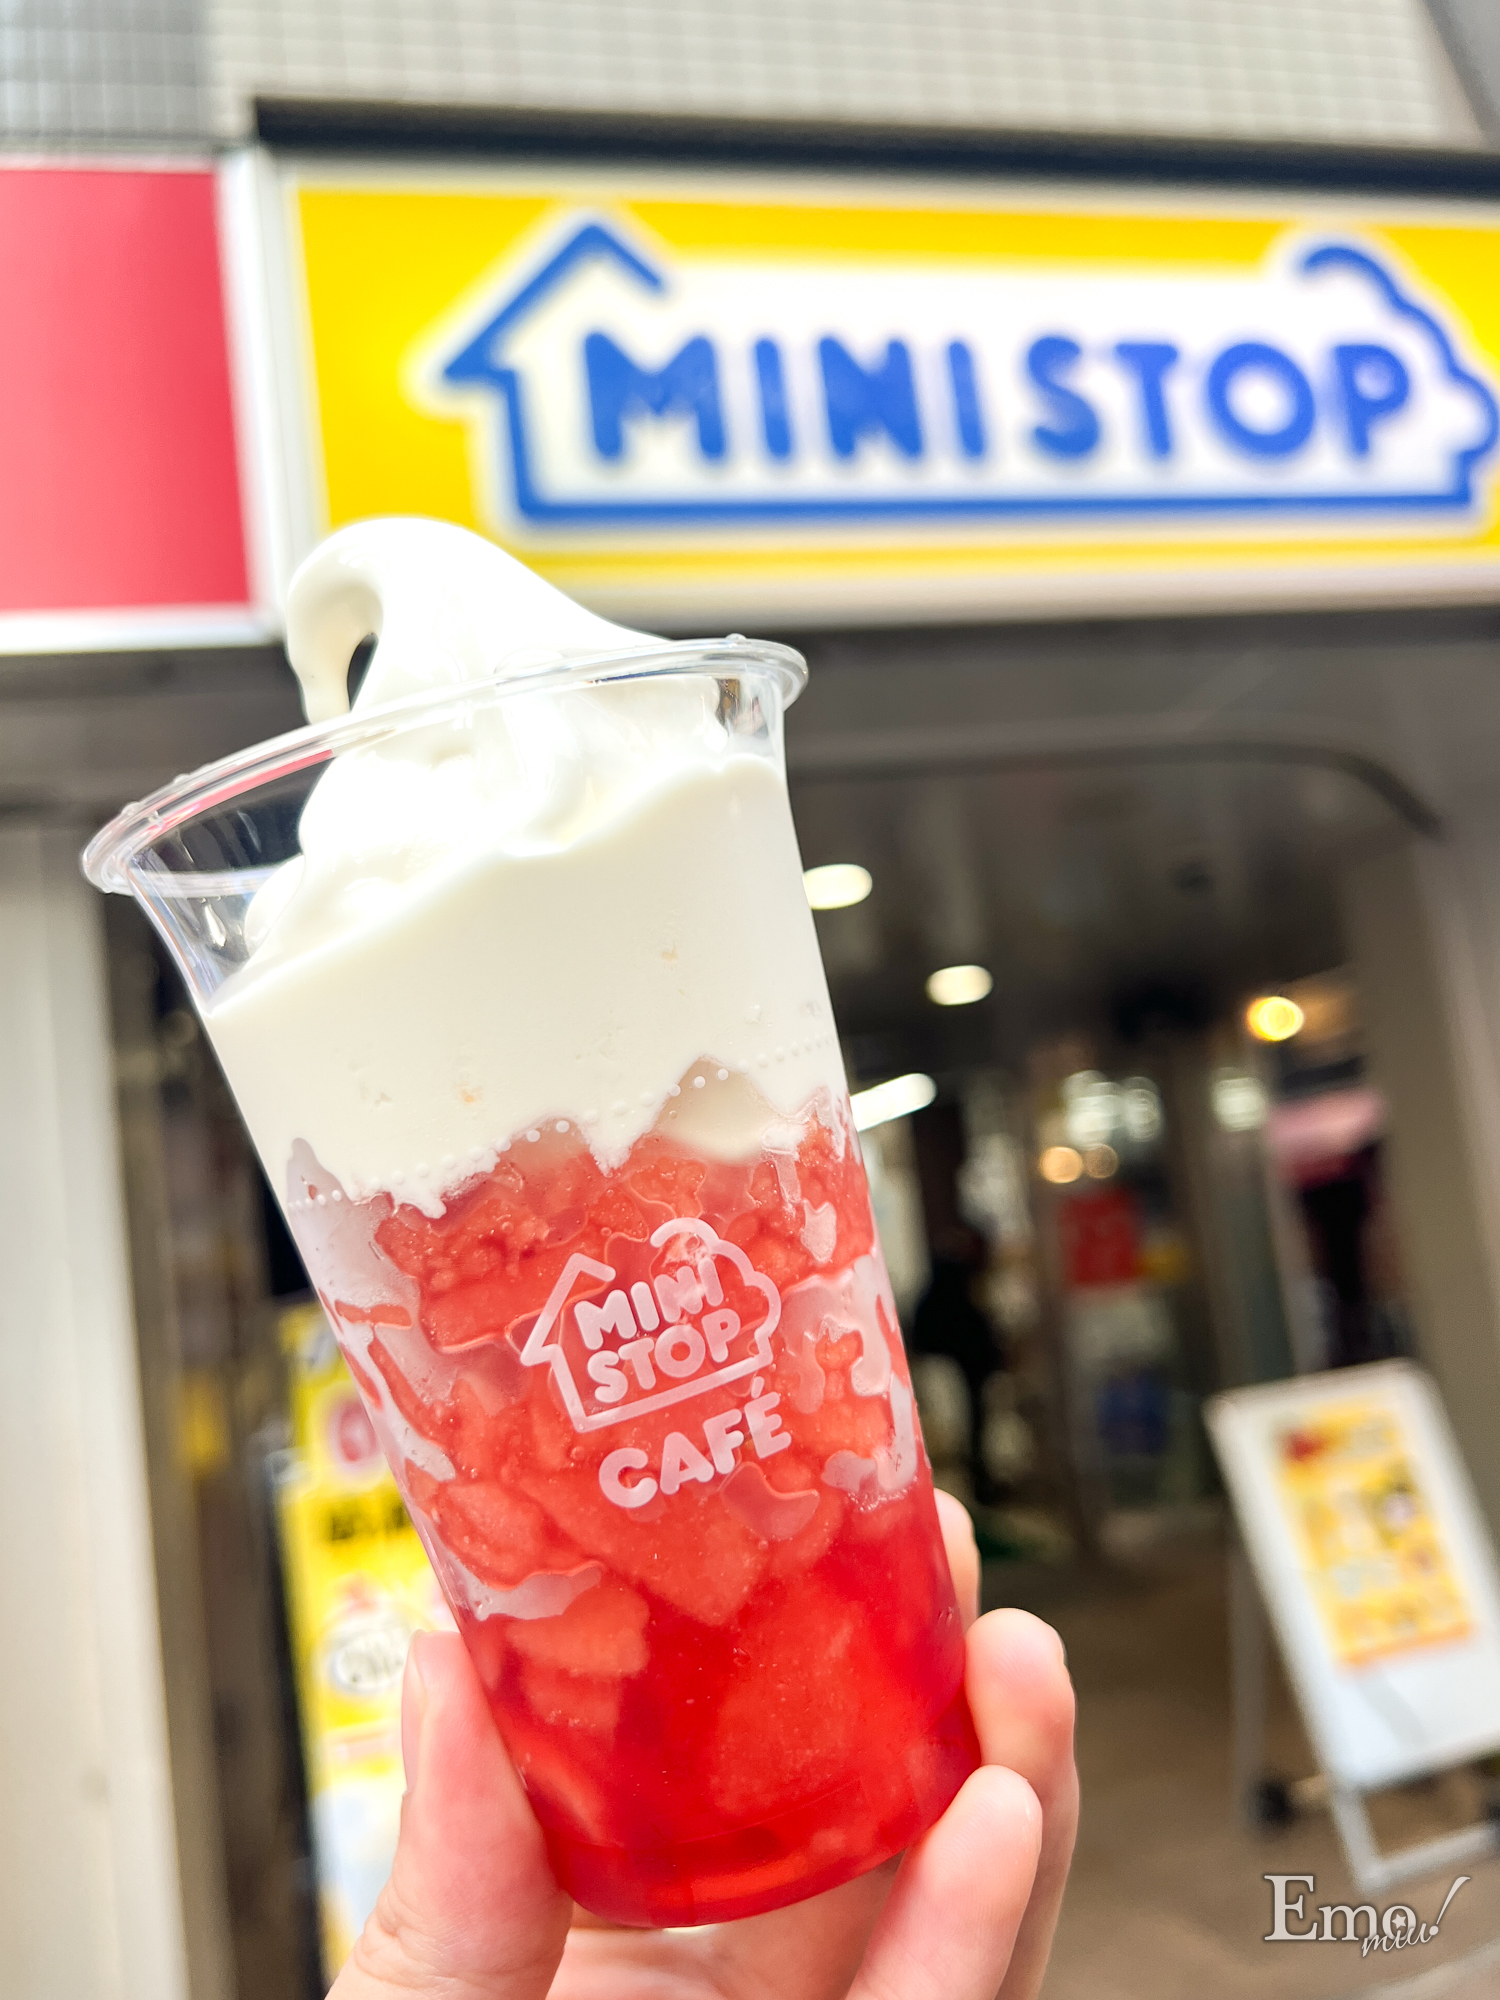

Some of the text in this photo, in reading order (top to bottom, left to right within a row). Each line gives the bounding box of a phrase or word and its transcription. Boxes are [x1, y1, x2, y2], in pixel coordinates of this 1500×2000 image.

[574, 1257, 724, 1350] MINI
[587, 1308, 741, 1403] STOP
[598, 1376, 792, 1508] CAFÉ
